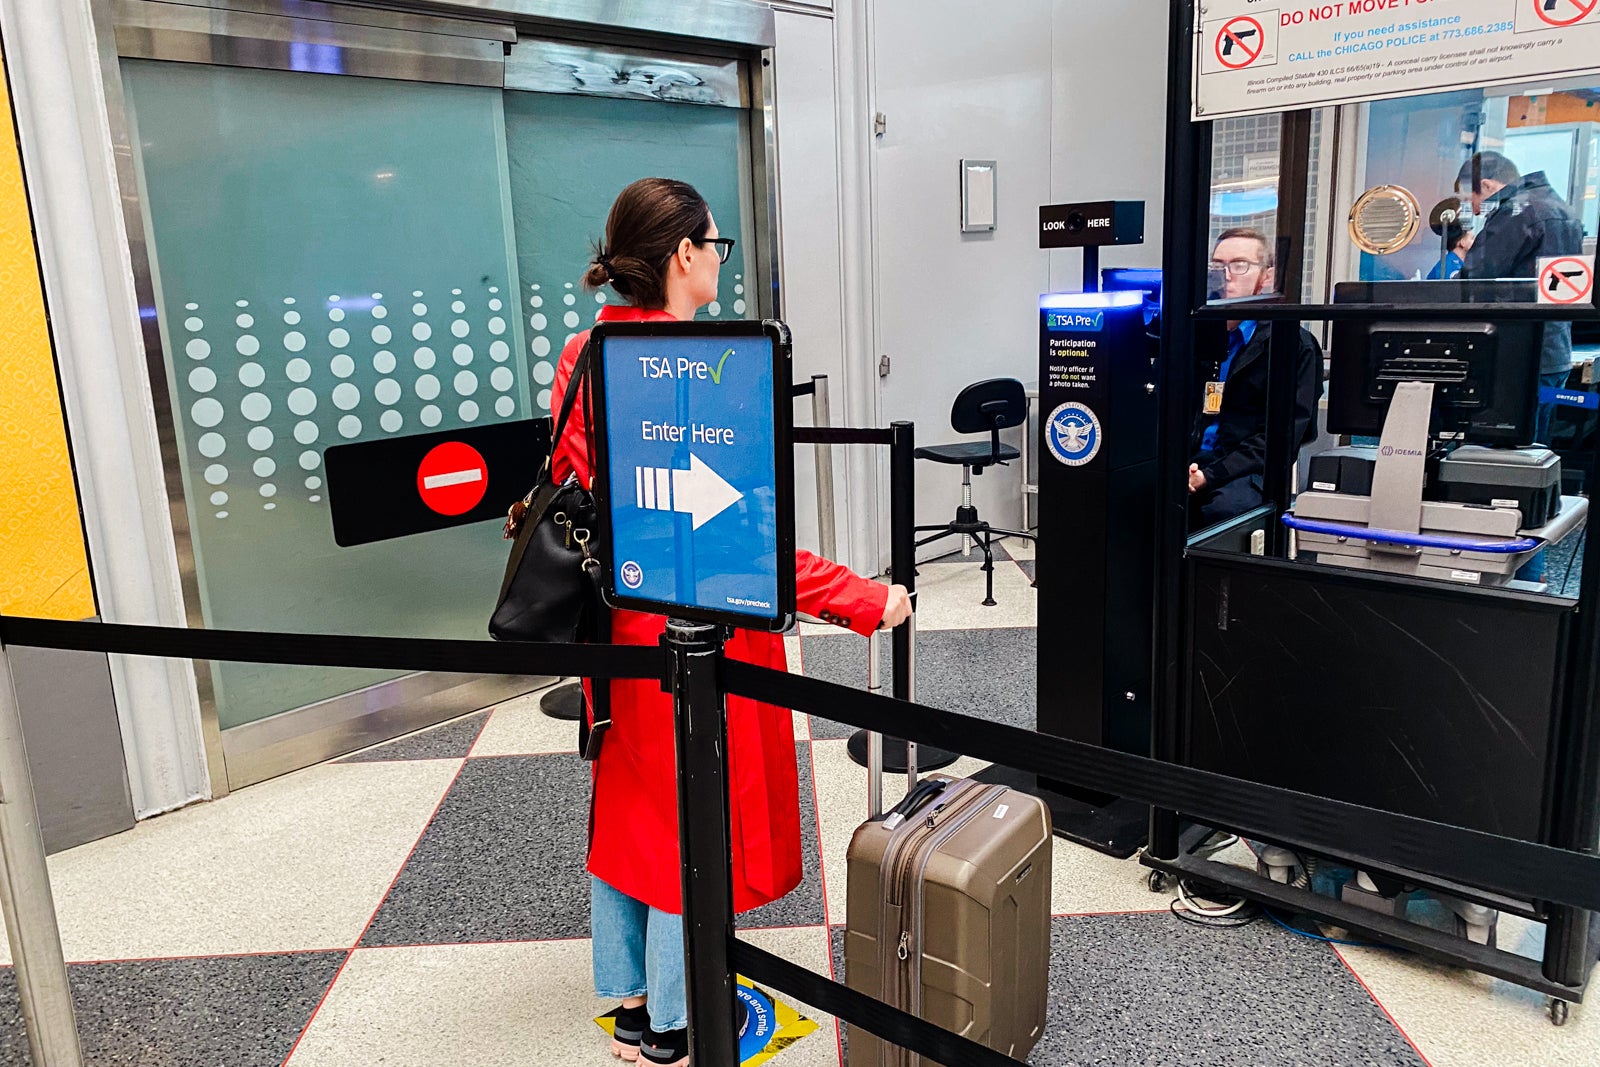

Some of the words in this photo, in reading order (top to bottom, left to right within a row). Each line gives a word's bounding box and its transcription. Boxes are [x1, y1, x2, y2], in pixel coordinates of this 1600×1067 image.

[1281, 10, 1304, 27] DO
[1309, 3, 1344, 22] NOT
[1348, 0, 1399, 15] MOVE
[1333, 31, 1341, 42] If
[1344, 30, 1364, 43] you
[1367, 23, 1395, 37] need
[1398, 14, 1461, 32] assistance
[1288, 50, 1314, 62] CALL
[1317, 46, 1332, 57] the
[1335, 40, 1383, 56] CHICAGO
[1386, 33, 1426, 48] POLICE
[1429, 32, 1440, 42] at
[1442, 20, 1514, 39] 773.686.2385
[1266, 75, 1293, 85] Compiled
[1294, 72, 1316, 80] Statute
[1394, 56, 1420, 67] conceal
[1421, 54, 1438, 64] carry
[1439, 50, 1467, 60] licensee
[1469, 47, 1485, 56] shall
[1499, 41, 1536, 52] knowingly
[1537, 38, 1556, 48] carry
[1347, 72, 1374, 82] property
[1382, 68, 1406, 78] parking
[1424, 62, 1444, 71] under
[1445, 59, 1468, 69] control
[1043, 221, 1065, 231] LOOK
[1087, 217, 1110, 228] HERE
[1056, 315, 1074, 326] TSA
[1075, 315, 1091, 326] Pre
[1049, 339, 1096, 348] Participation
[1049, 348, 1056, 356] is
[1057, 349, 1090, 357] optional.
[638, 356, 673, 379] TSA
[677, 357, 708, 380] Pre
[1049, 365, 1067, 373] Notify
[1071, 381, 1090, 389] taken.
[641, 420, 686, 442] Enter
[691, 423, 735, 445] Here
[1394, 448, 1423, 456] IDEMIA
[749, 1000, 767, 1014] and
[756, 1014, 768, 1036] smile
